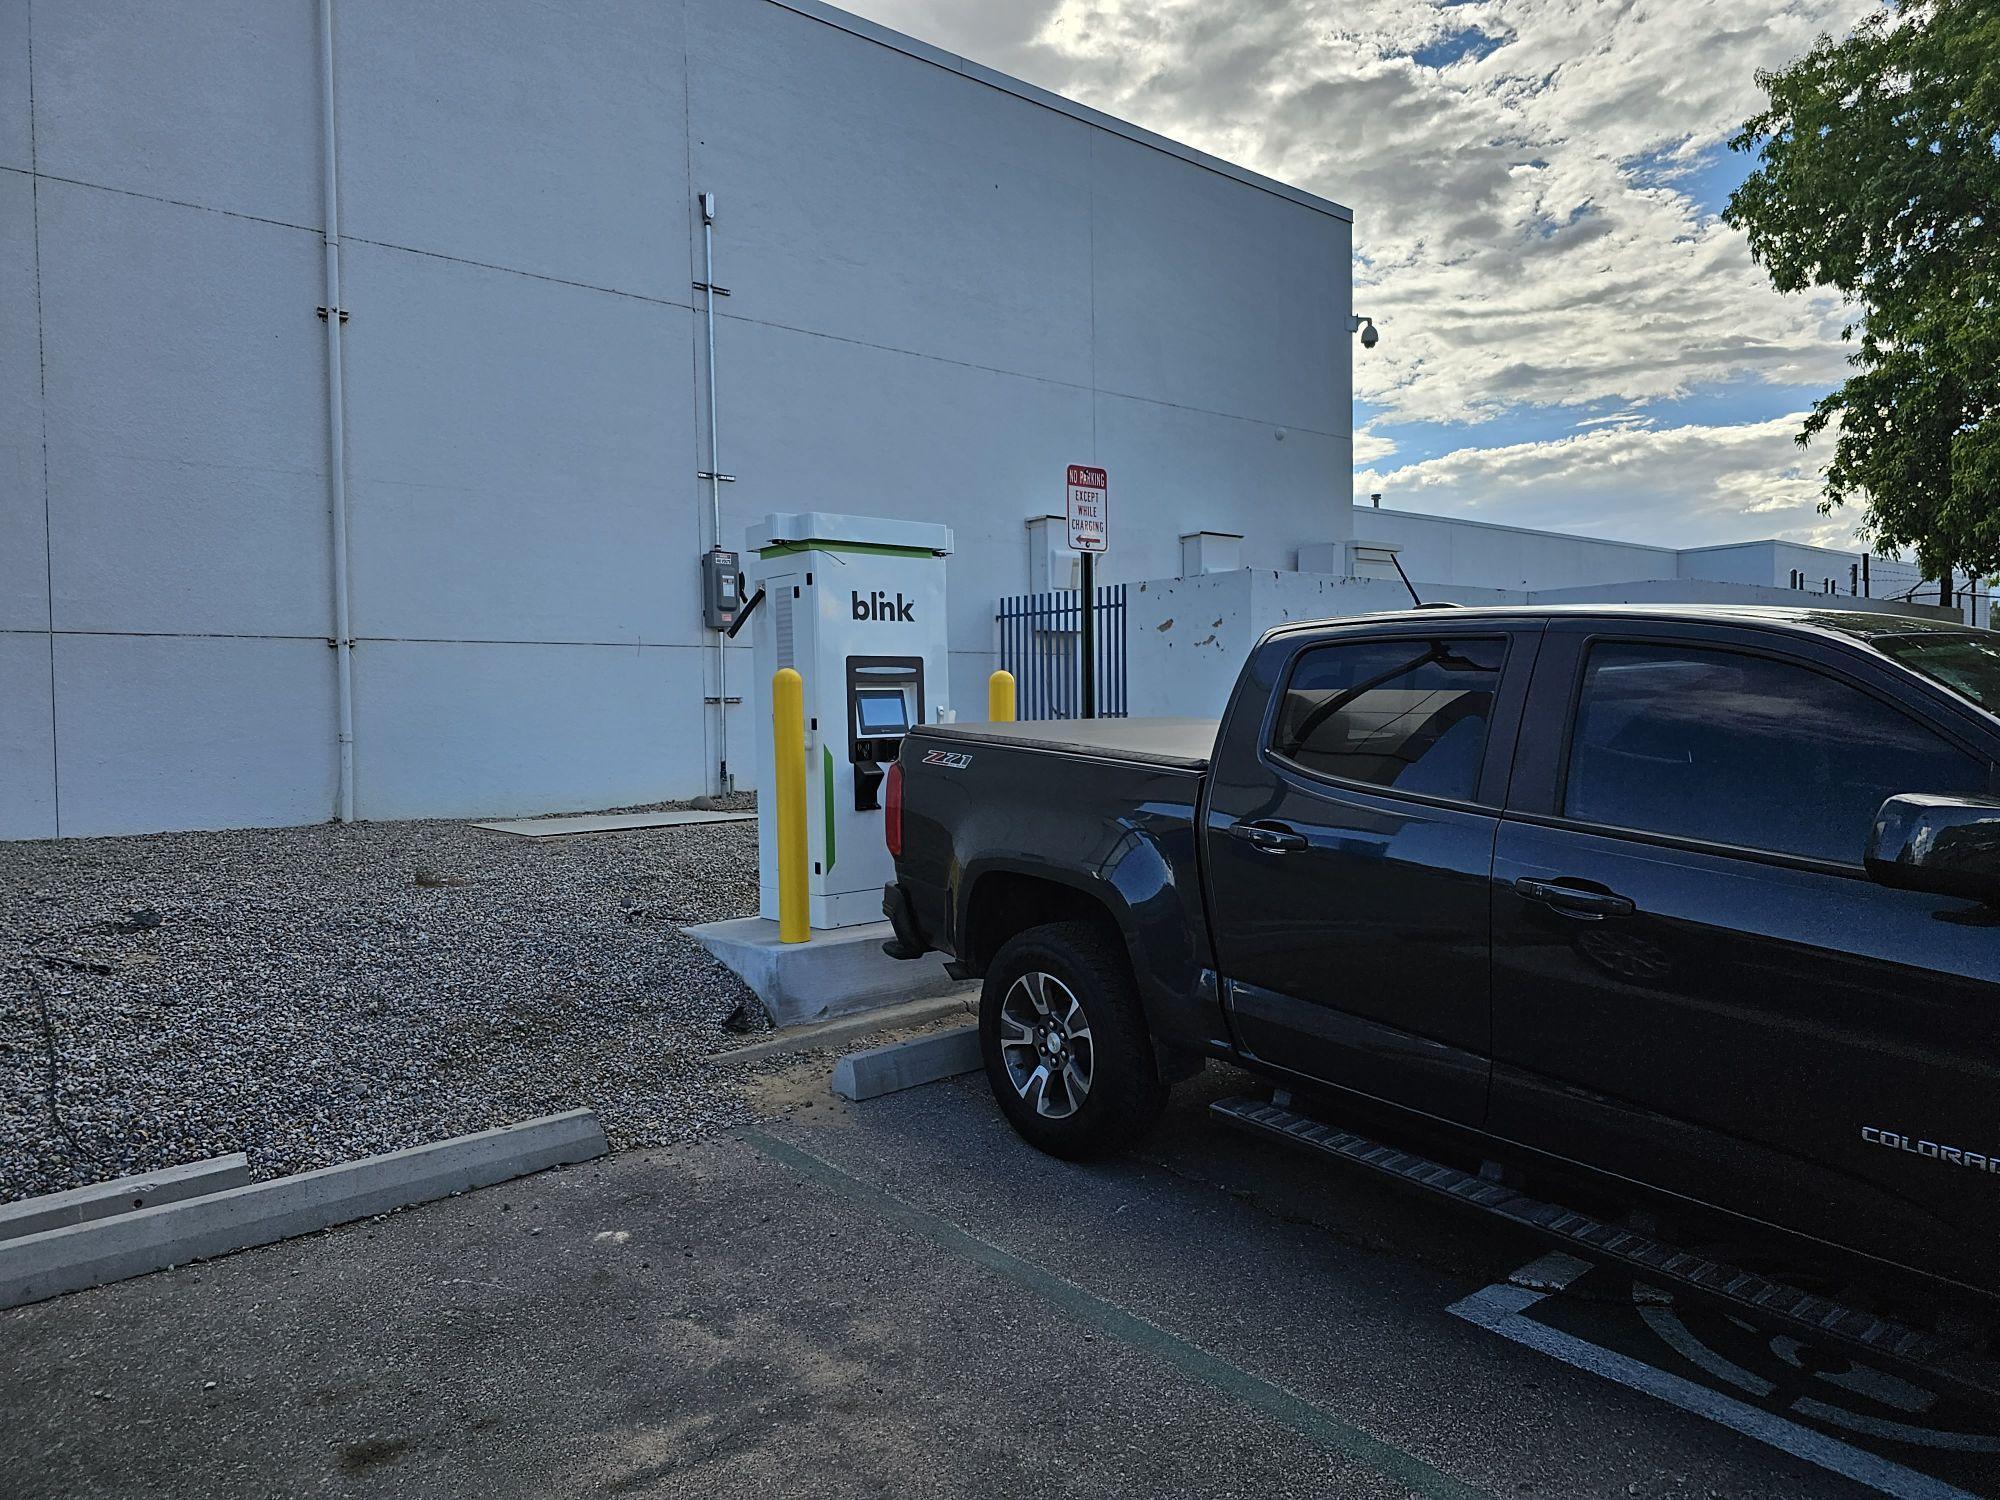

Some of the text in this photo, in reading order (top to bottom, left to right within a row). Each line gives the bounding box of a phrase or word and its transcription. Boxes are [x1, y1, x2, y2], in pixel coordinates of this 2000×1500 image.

[1069, 469, 1105, 487] NO PARKING
[1075, 490, 1099, 503] EXCEPT
[1077, 505, 1097, 518] WHILE
[1071, 519, 1104, 533] CHARGING
[851, 590, 916, 622] blink
[921, 749, 973, 769] Z71
